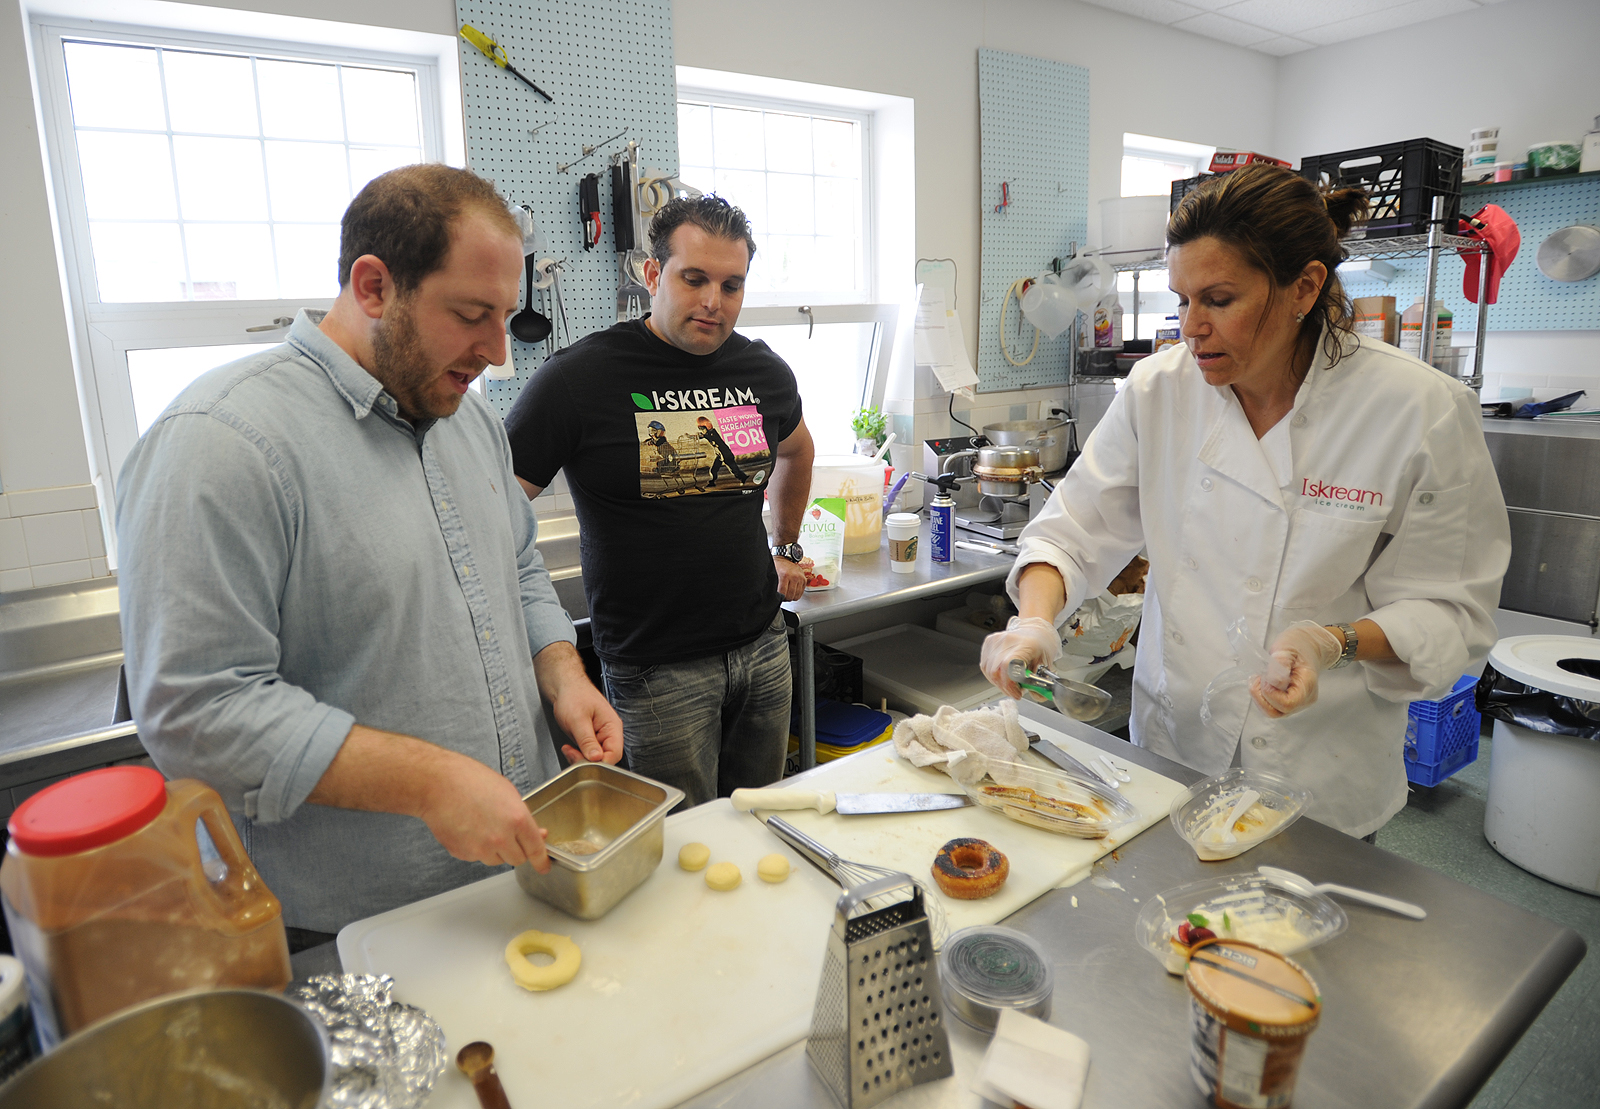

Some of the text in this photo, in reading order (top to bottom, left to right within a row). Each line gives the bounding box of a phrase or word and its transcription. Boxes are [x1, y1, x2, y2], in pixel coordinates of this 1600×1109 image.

[717, 415, 738, 424] TASTE
[720, 418, 762, 432] SKREAMING
[723, 426, 766, 448] FOR!
[1301, 477, 1383, 506] Iskream
[1315, 498, 1365, 512] ice cream
